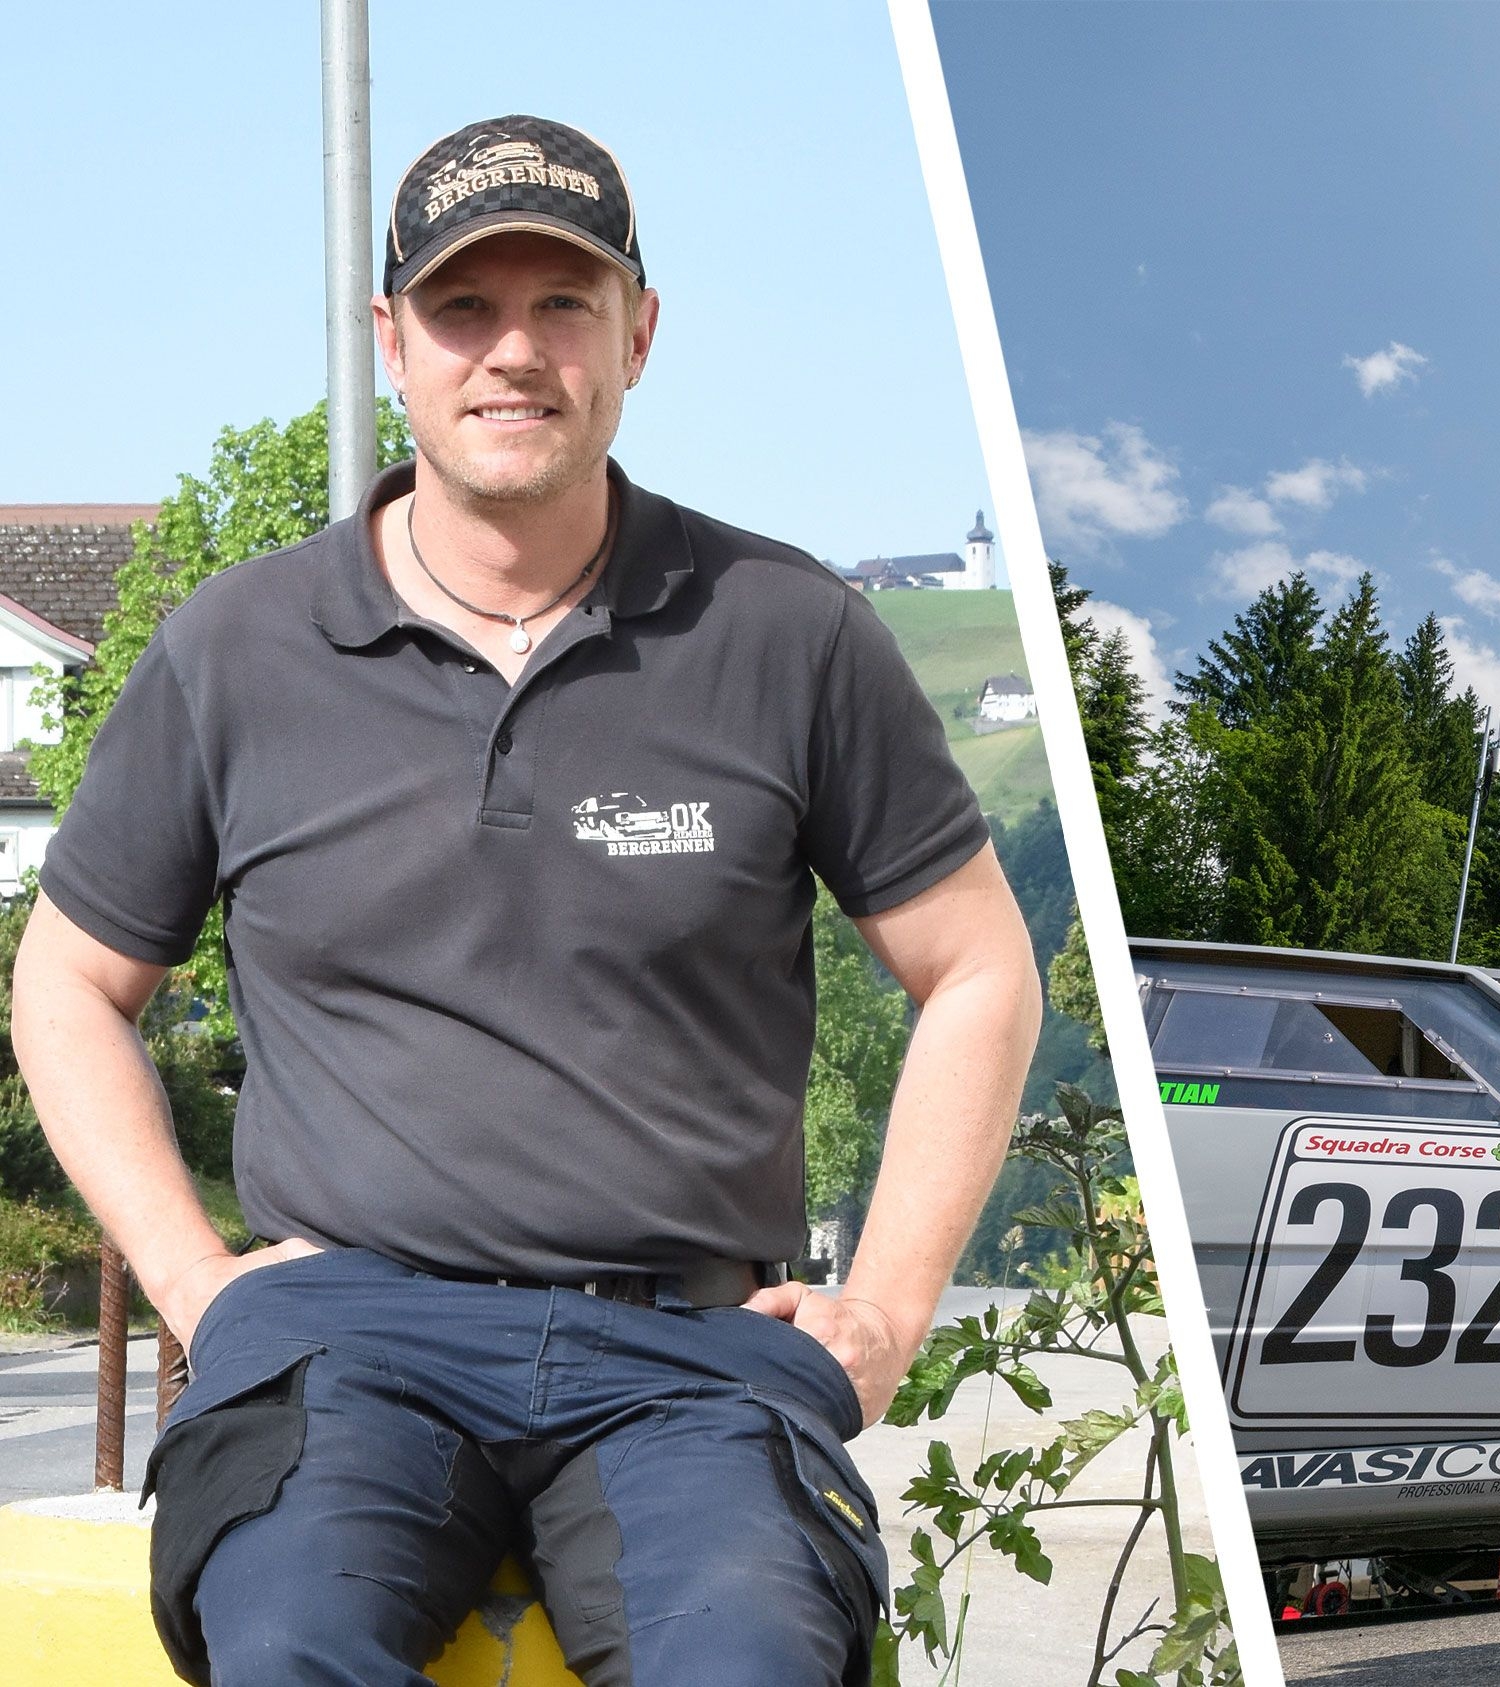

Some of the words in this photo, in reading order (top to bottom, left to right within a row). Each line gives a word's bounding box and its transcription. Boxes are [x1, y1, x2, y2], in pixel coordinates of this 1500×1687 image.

[424, 166, 600, 224] BERGRENNEN
[671, 802, 712, 831] OK
[607, 838, 715, 856] BERGRENNEN
[1160, 1082, 1220, 1104] TIAN
[1305, 1135, 1411, 1159] Squadra
[1418, 1141, 1487, 1158] Corse
[1397, 1480, 1485, 1499] PROFESSIONAL
